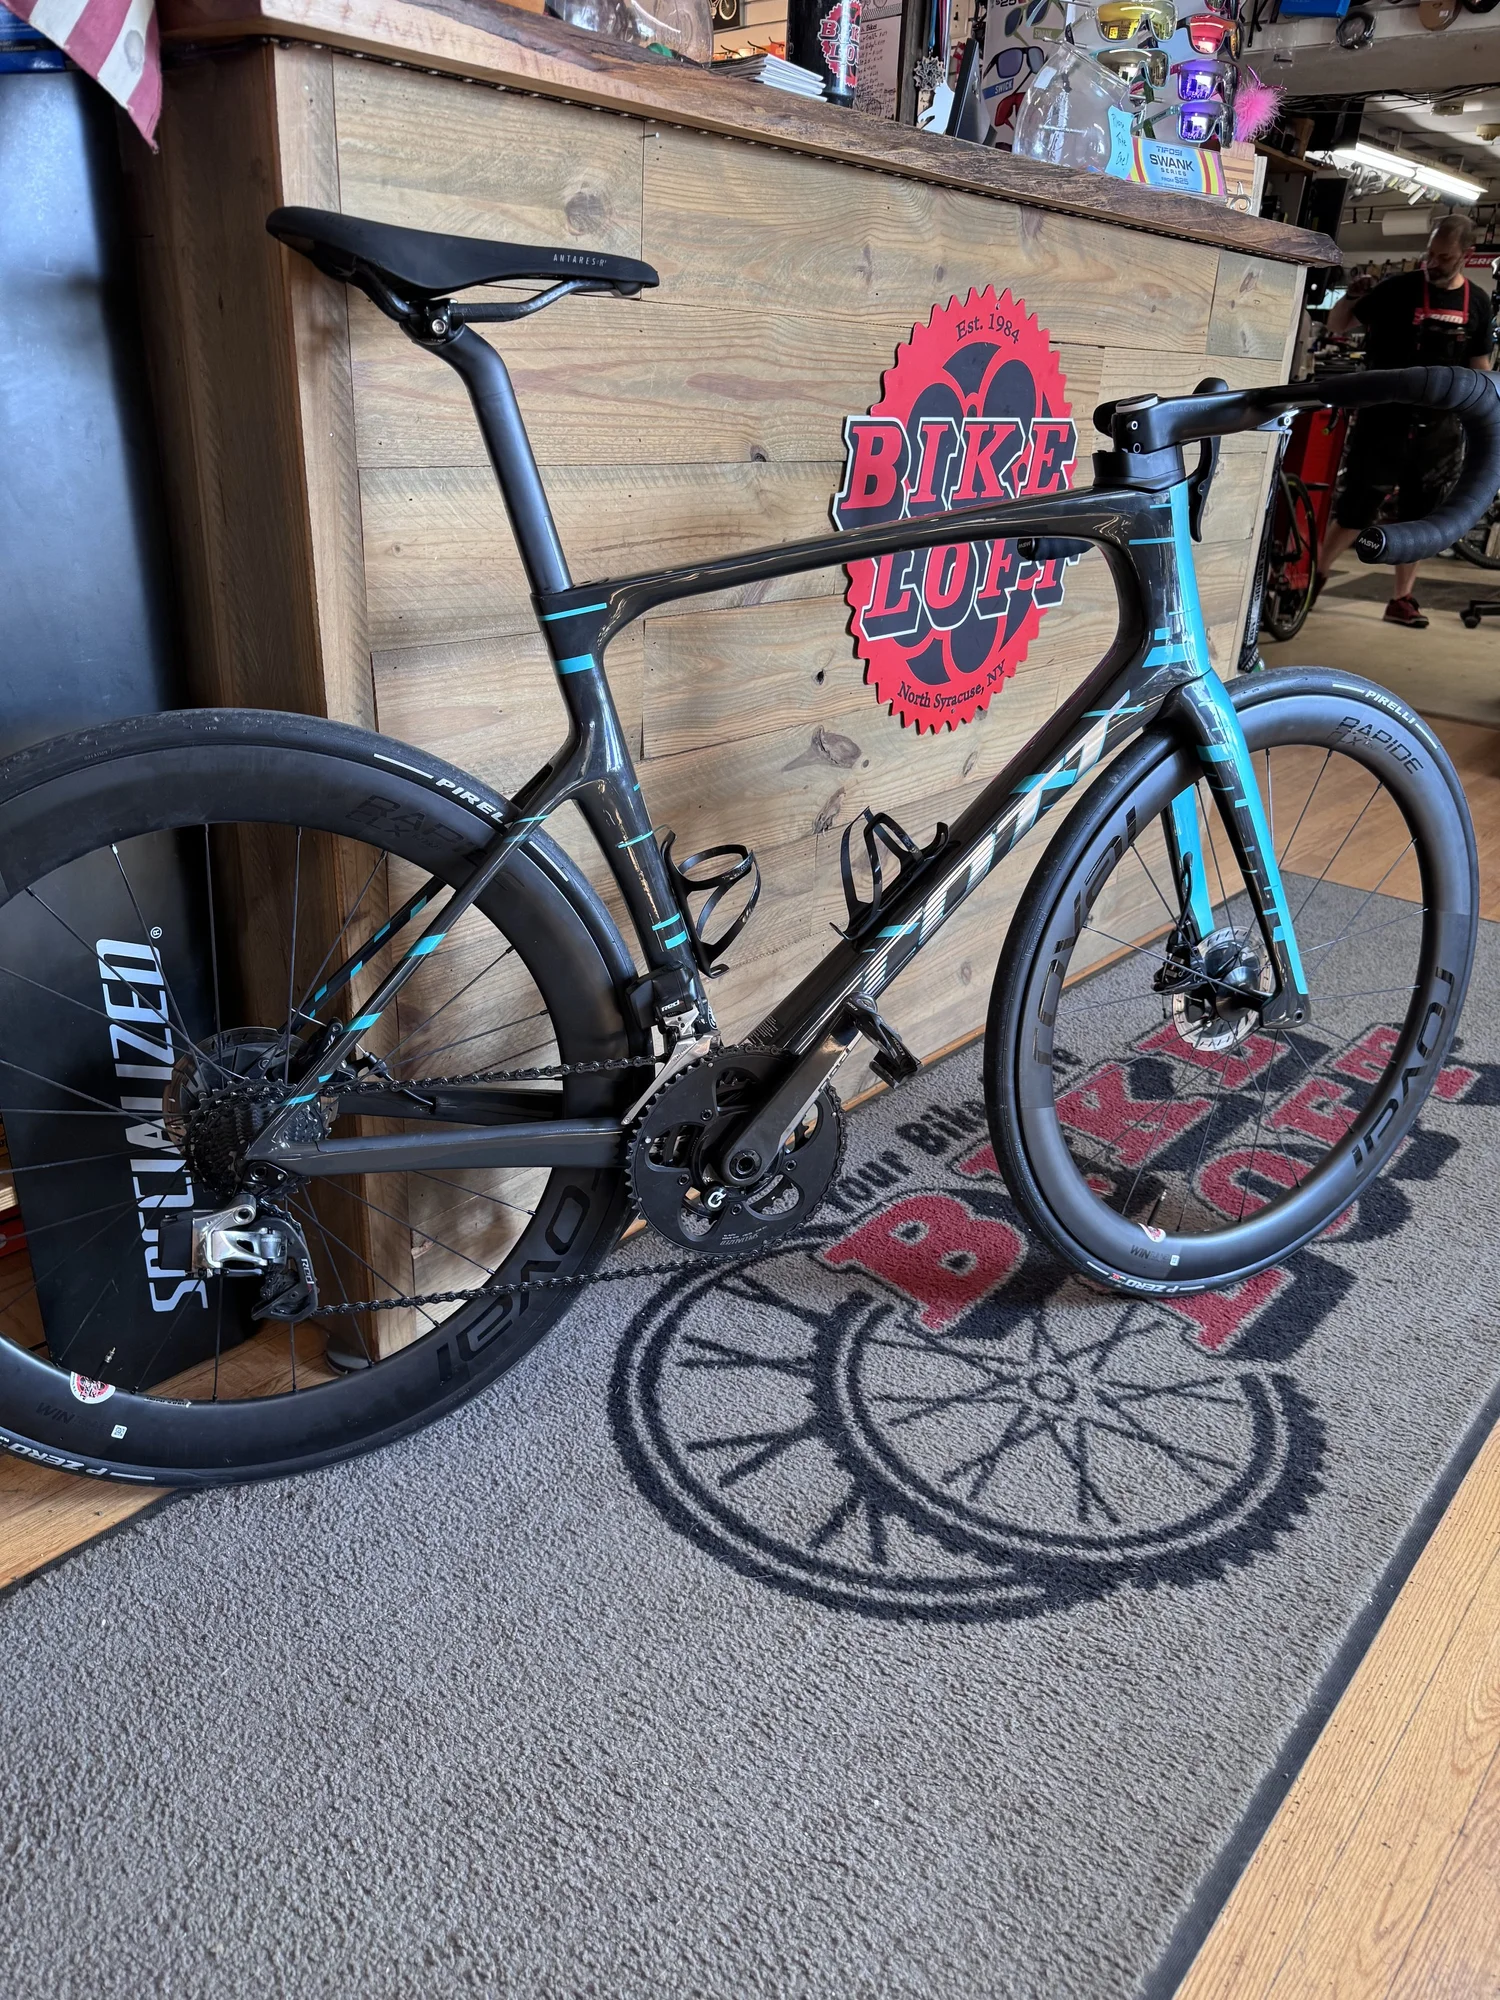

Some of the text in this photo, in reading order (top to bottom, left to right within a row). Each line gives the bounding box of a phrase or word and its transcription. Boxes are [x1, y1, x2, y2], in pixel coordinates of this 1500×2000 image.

[1149, 153, 1195, 172] SWANK
[1156, 145, 1183, 156] TIFOSI
[1160, 167, 1187, 177] SERIES
[553, 253, 596, 266] ANTARES
[955, 313, 1020, 344] Est. 1984
[836, 418, 1074, 516] BIKE
[1358, 537, 1380, 550] MSW
[897, 659, 1006, 712] North Syracuse, NY
[1365, 690, 1416, 725] PIRELLI
[1338, 715, 1424, 775] RAPIDE
[435, 778, 505, 824] PIREL
[1125, 1279, 1167, 1293] ZERO
[8, 1443, 108, 1477] P ZERO
